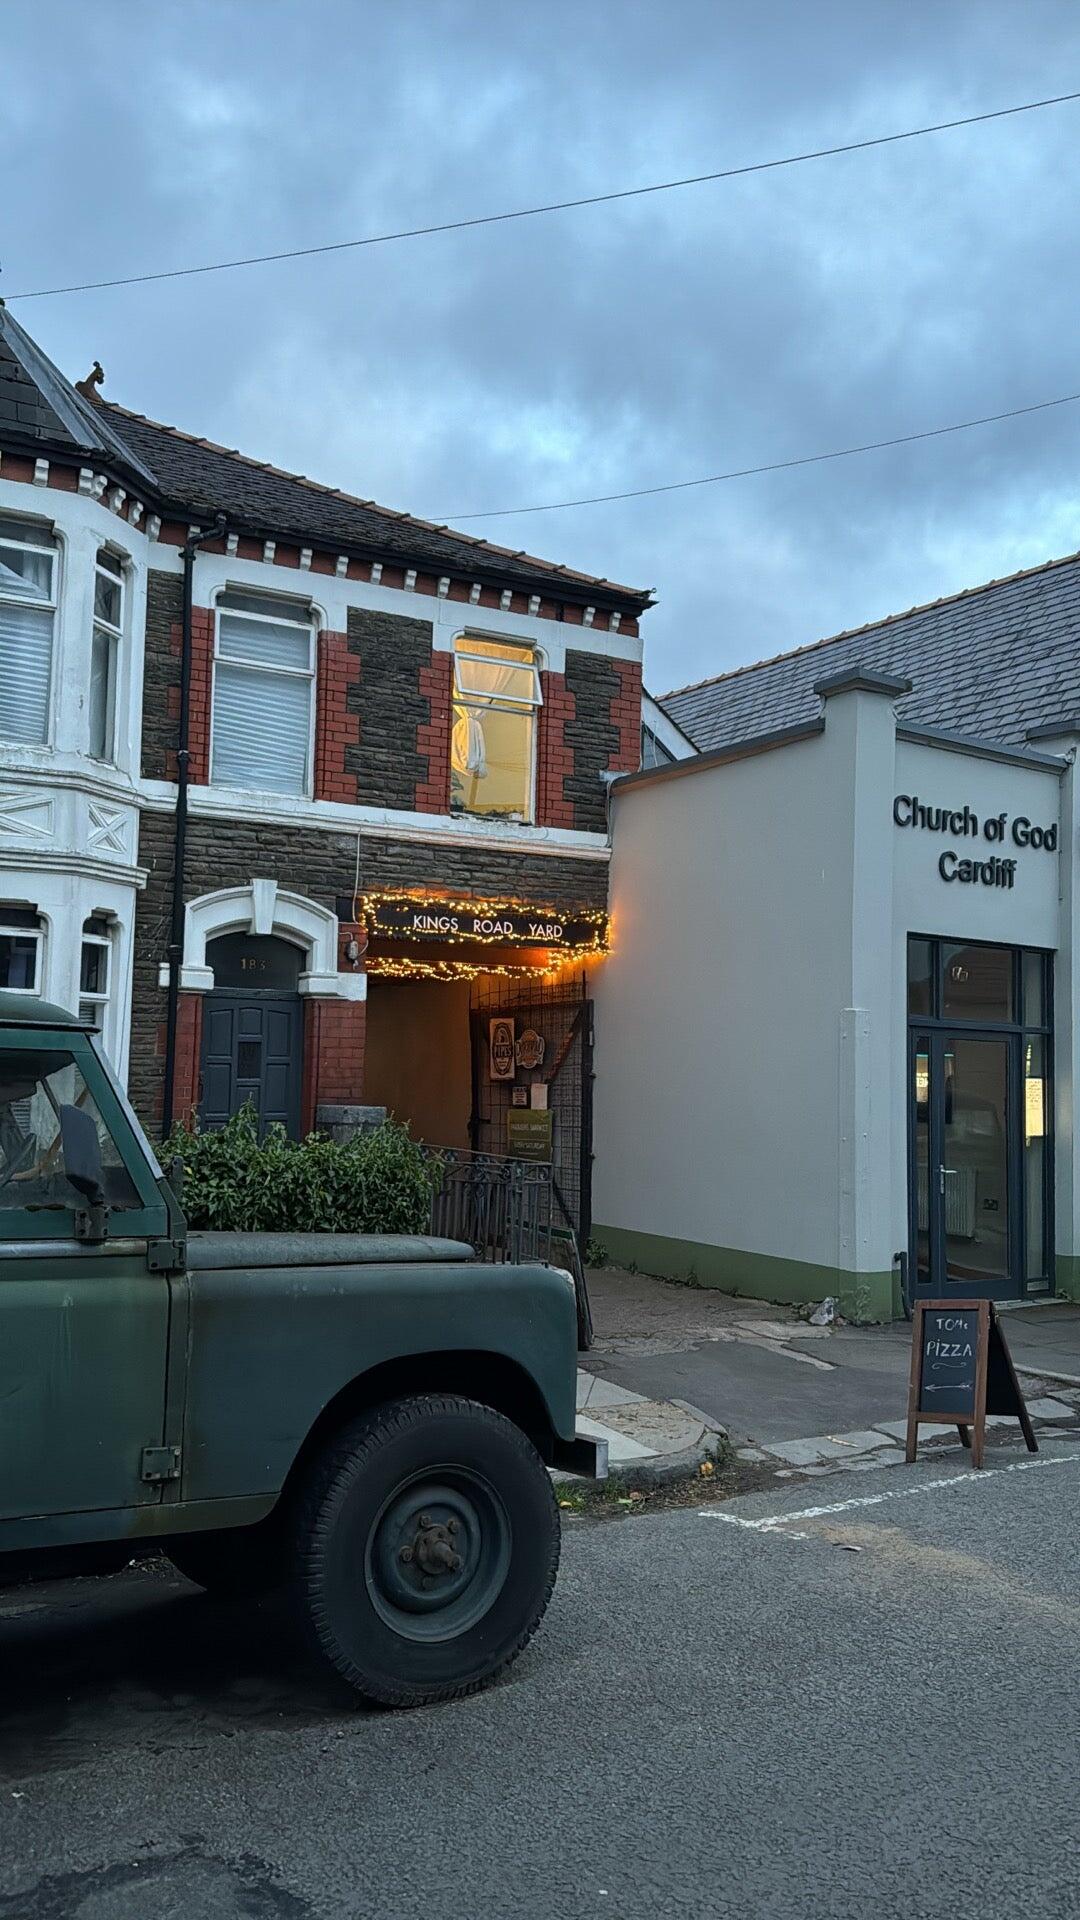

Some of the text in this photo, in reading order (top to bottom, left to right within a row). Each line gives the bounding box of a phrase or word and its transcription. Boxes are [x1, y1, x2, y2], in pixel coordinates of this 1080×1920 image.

[893, 794, 1058, 851] Church of God
[938, 850, 1017, 889] Cardiff
[413, 915, 563, 938] KINGS ROAD YARD
[494, 1045, 512, 1057] PIPES
